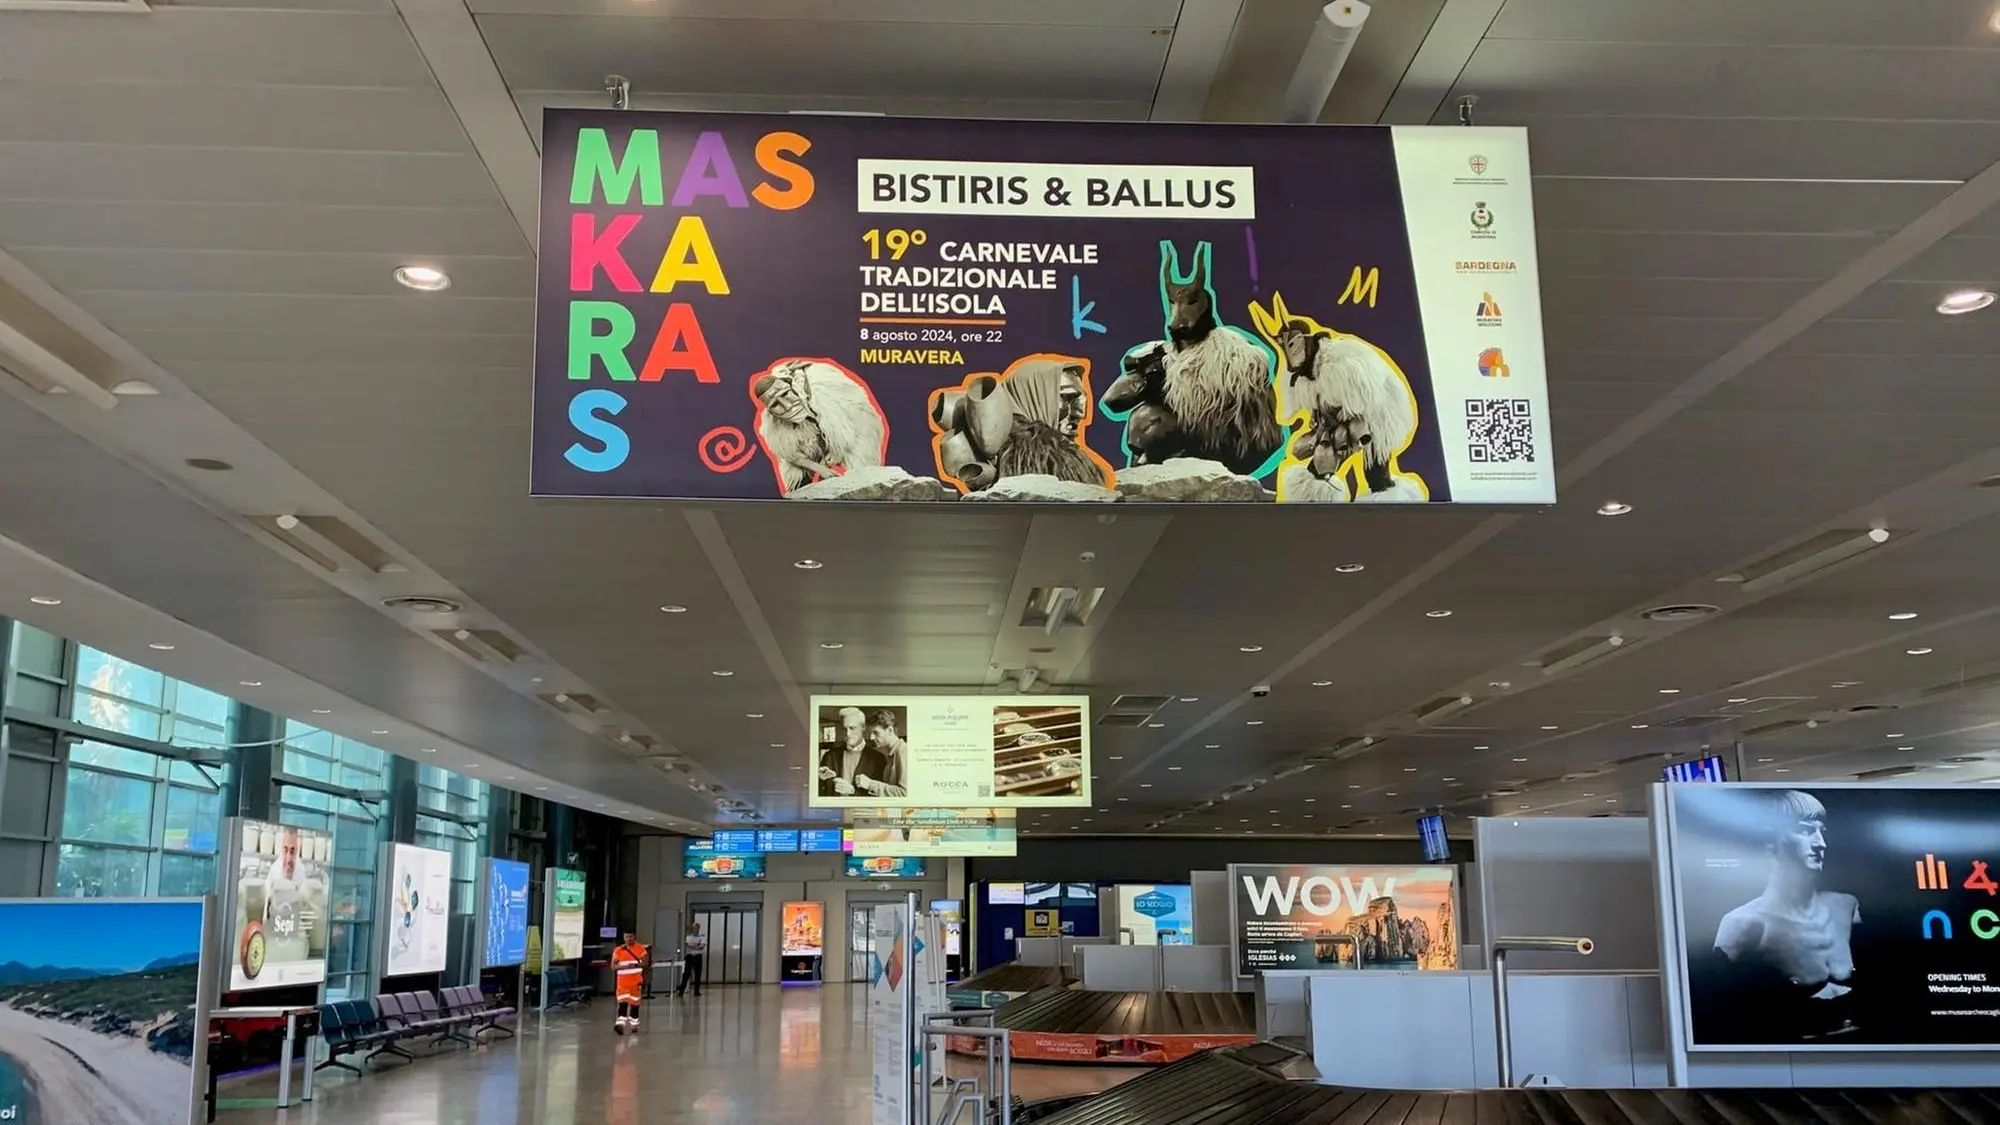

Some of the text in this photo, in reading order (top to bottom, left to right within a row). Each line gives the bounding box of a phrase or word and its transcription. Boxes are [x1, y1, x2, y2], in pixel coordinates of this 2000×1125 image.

[569, 127, 815, 210] MAS
[873, 173, 1236, 209] BISTIRIS & BALLUS
[570, 213, 730, 294] KA
[939, 242, 1098, 264] CARNEVALE
[1455, 261, 1517, 270] SARDEGNA
[860, 266, 1057, 289] TRADIZIONALE
[861, 292, 1006, 315] DELL'ISOLA
[568, 300, 721, 383] RA
[860, 328, 1003, 344] 8 agosto 2024, ore 22
[860, 349, 965, 365] MURAVERA
[563, 389, 630, 472] S
[1243, 876, 1396, 916] WOW
[274, 914, 294, 937] Sepi
[1928, 985, 1972, 994] Wednesday
[1982, 985, 2000, 993] Mon
